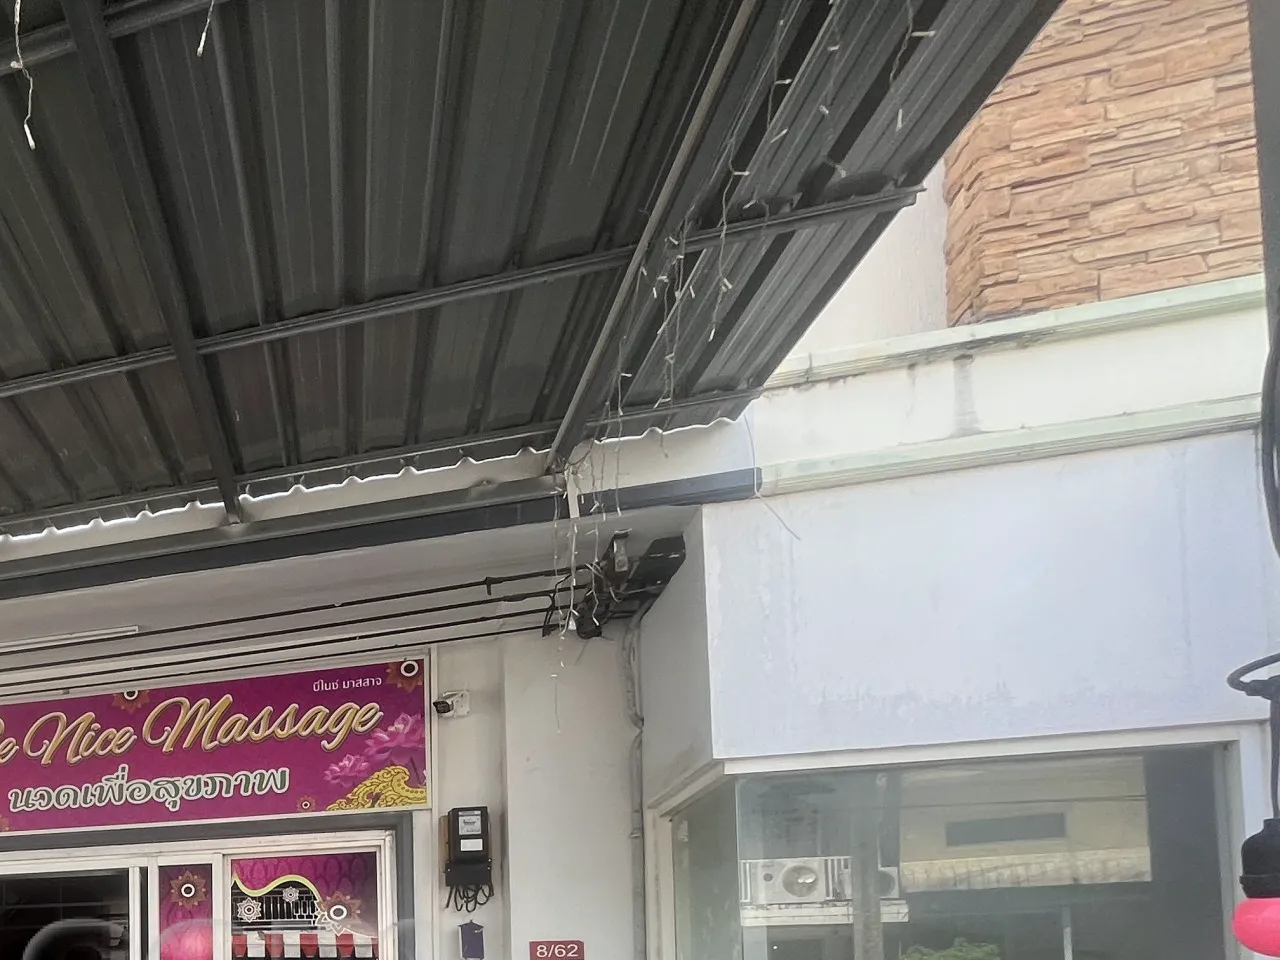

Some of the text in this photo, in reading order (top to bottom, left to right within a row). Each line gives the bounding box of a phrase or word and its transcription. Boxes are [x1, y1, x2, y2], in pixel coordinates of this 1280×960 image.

[22, 711, 138, 766] Nice
[141, 693, 385, 753] Massage
[8, 763, 290, 812] นวดเพื่อสุขภาพ
[536, 943, 579, 958] 8/62
